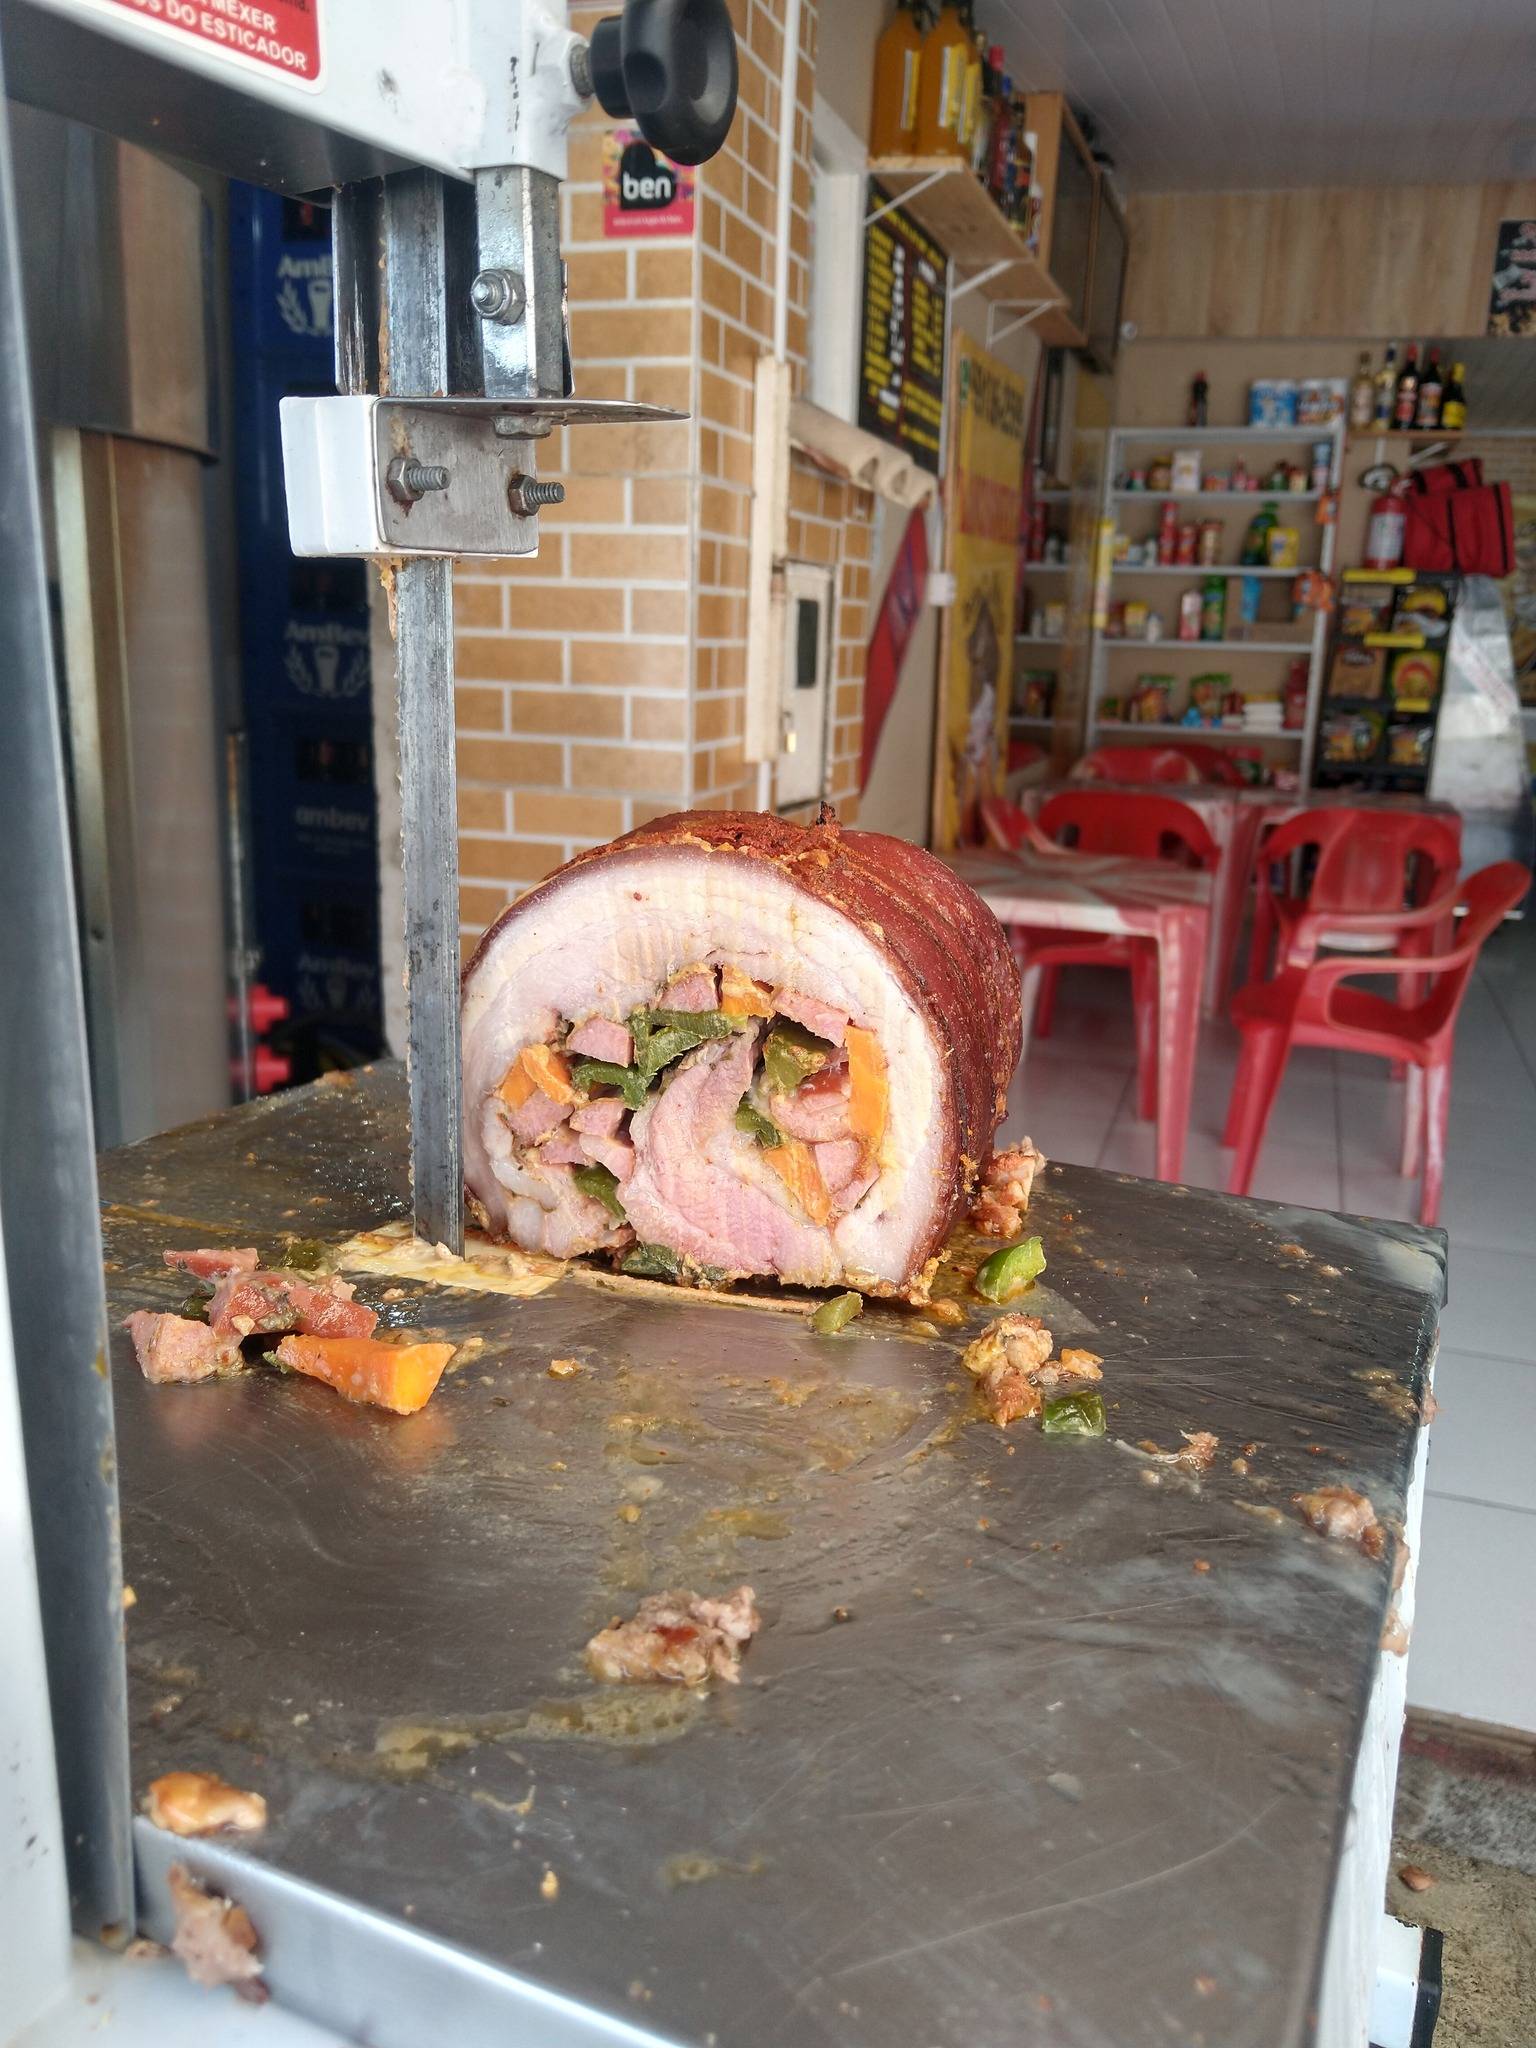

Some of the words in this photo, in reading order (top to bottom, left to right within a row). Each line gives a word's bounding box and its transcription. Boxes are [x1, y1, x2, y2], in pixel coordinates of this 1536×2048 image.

[210, 0, 277, 34] MEXER
[166, 1, 197, 25] DO
[200, 11, 307, 70] ESTICADOR
[622, 171, 672, 201] ben
[277, 254, 334, 278] AmB
